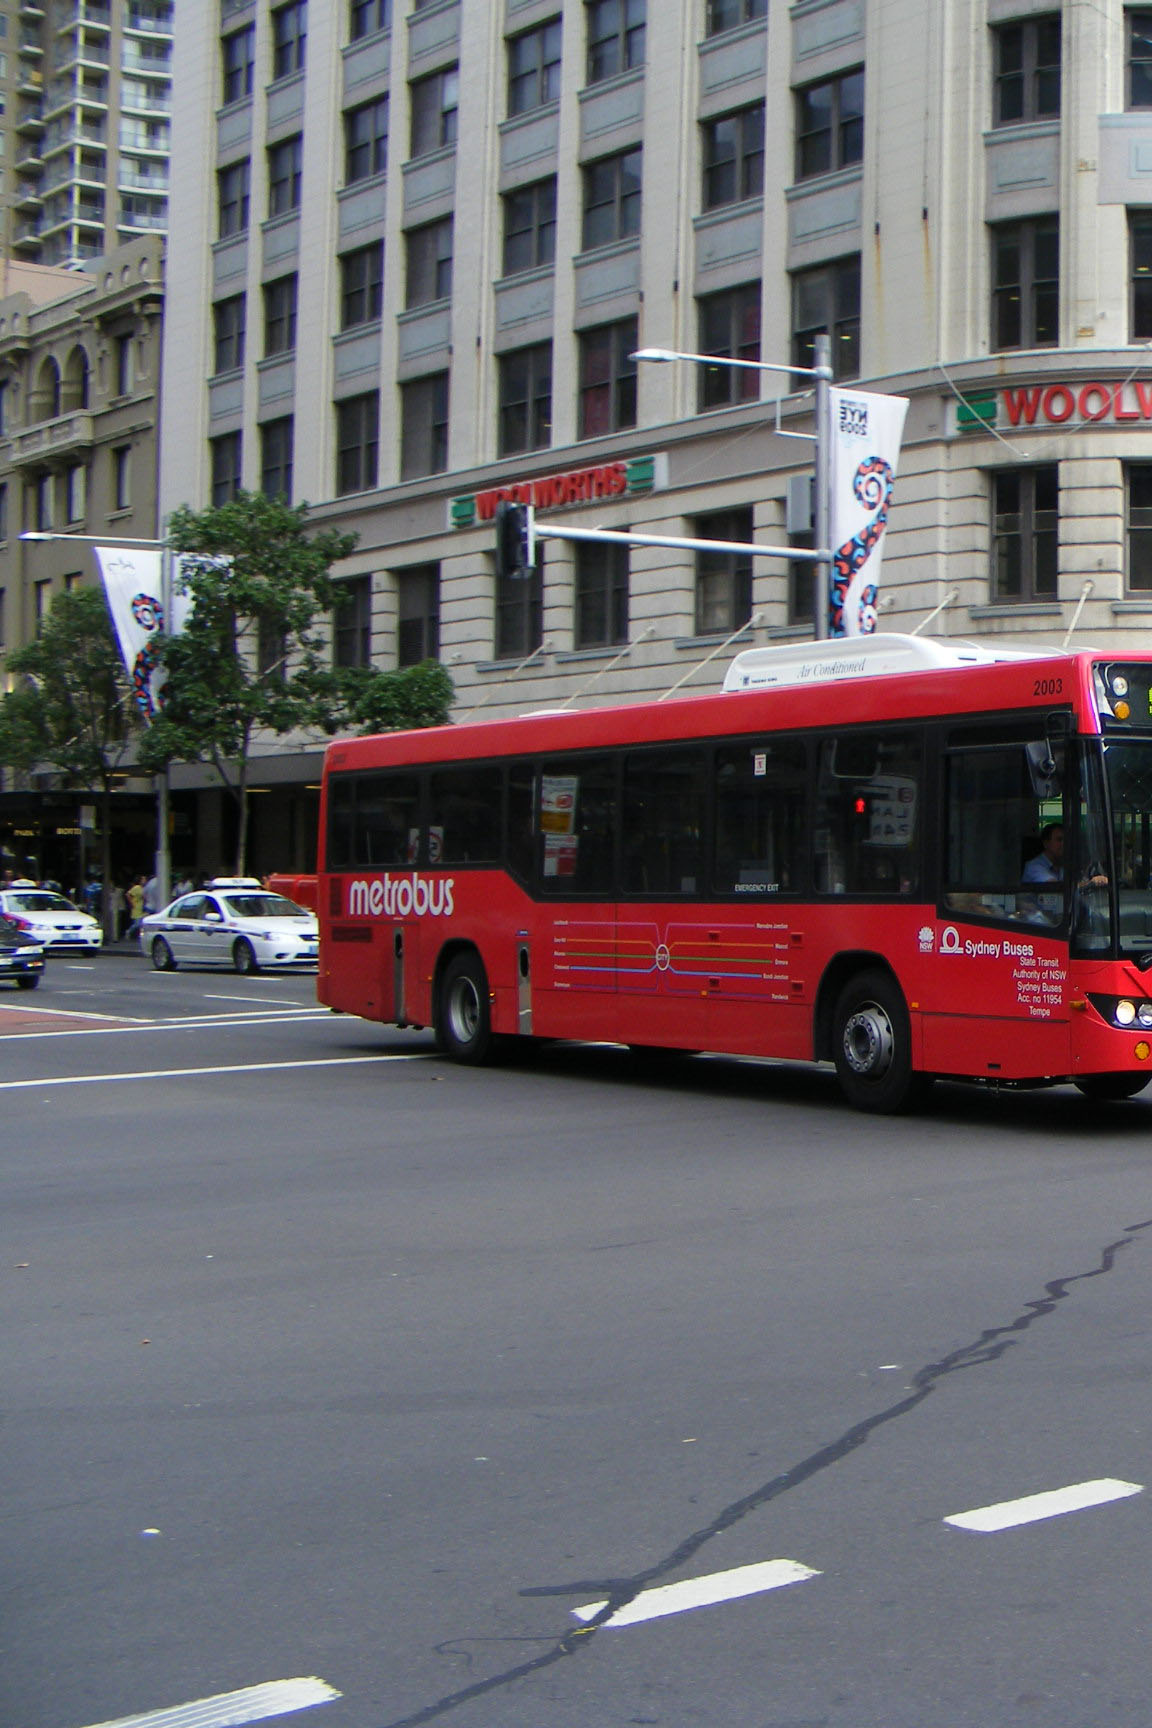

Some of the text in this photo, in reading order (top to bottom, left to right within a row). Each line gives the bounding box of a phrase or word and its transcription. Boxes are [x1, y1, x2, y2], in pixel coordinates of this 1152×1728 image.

[797, 658, 866, 679] Air Conditioned
[1033, 679, 1063, 696] 2003
[350, 872, 455, 916] metrobus
[735, 884, 779, 892] EMERGENCY EXIT
[965, 940, 1034, 958] Sydney Buses
[1020, 957, 1059, 967] State Transit
[1013, 969, 1067, 981] Authority of NSW
[1017, 981, 1063, 993] Sydney Buses
[1042, 994, 1062, 1005] 11954
[1029, 1006, 1051, 1019] Tempe
